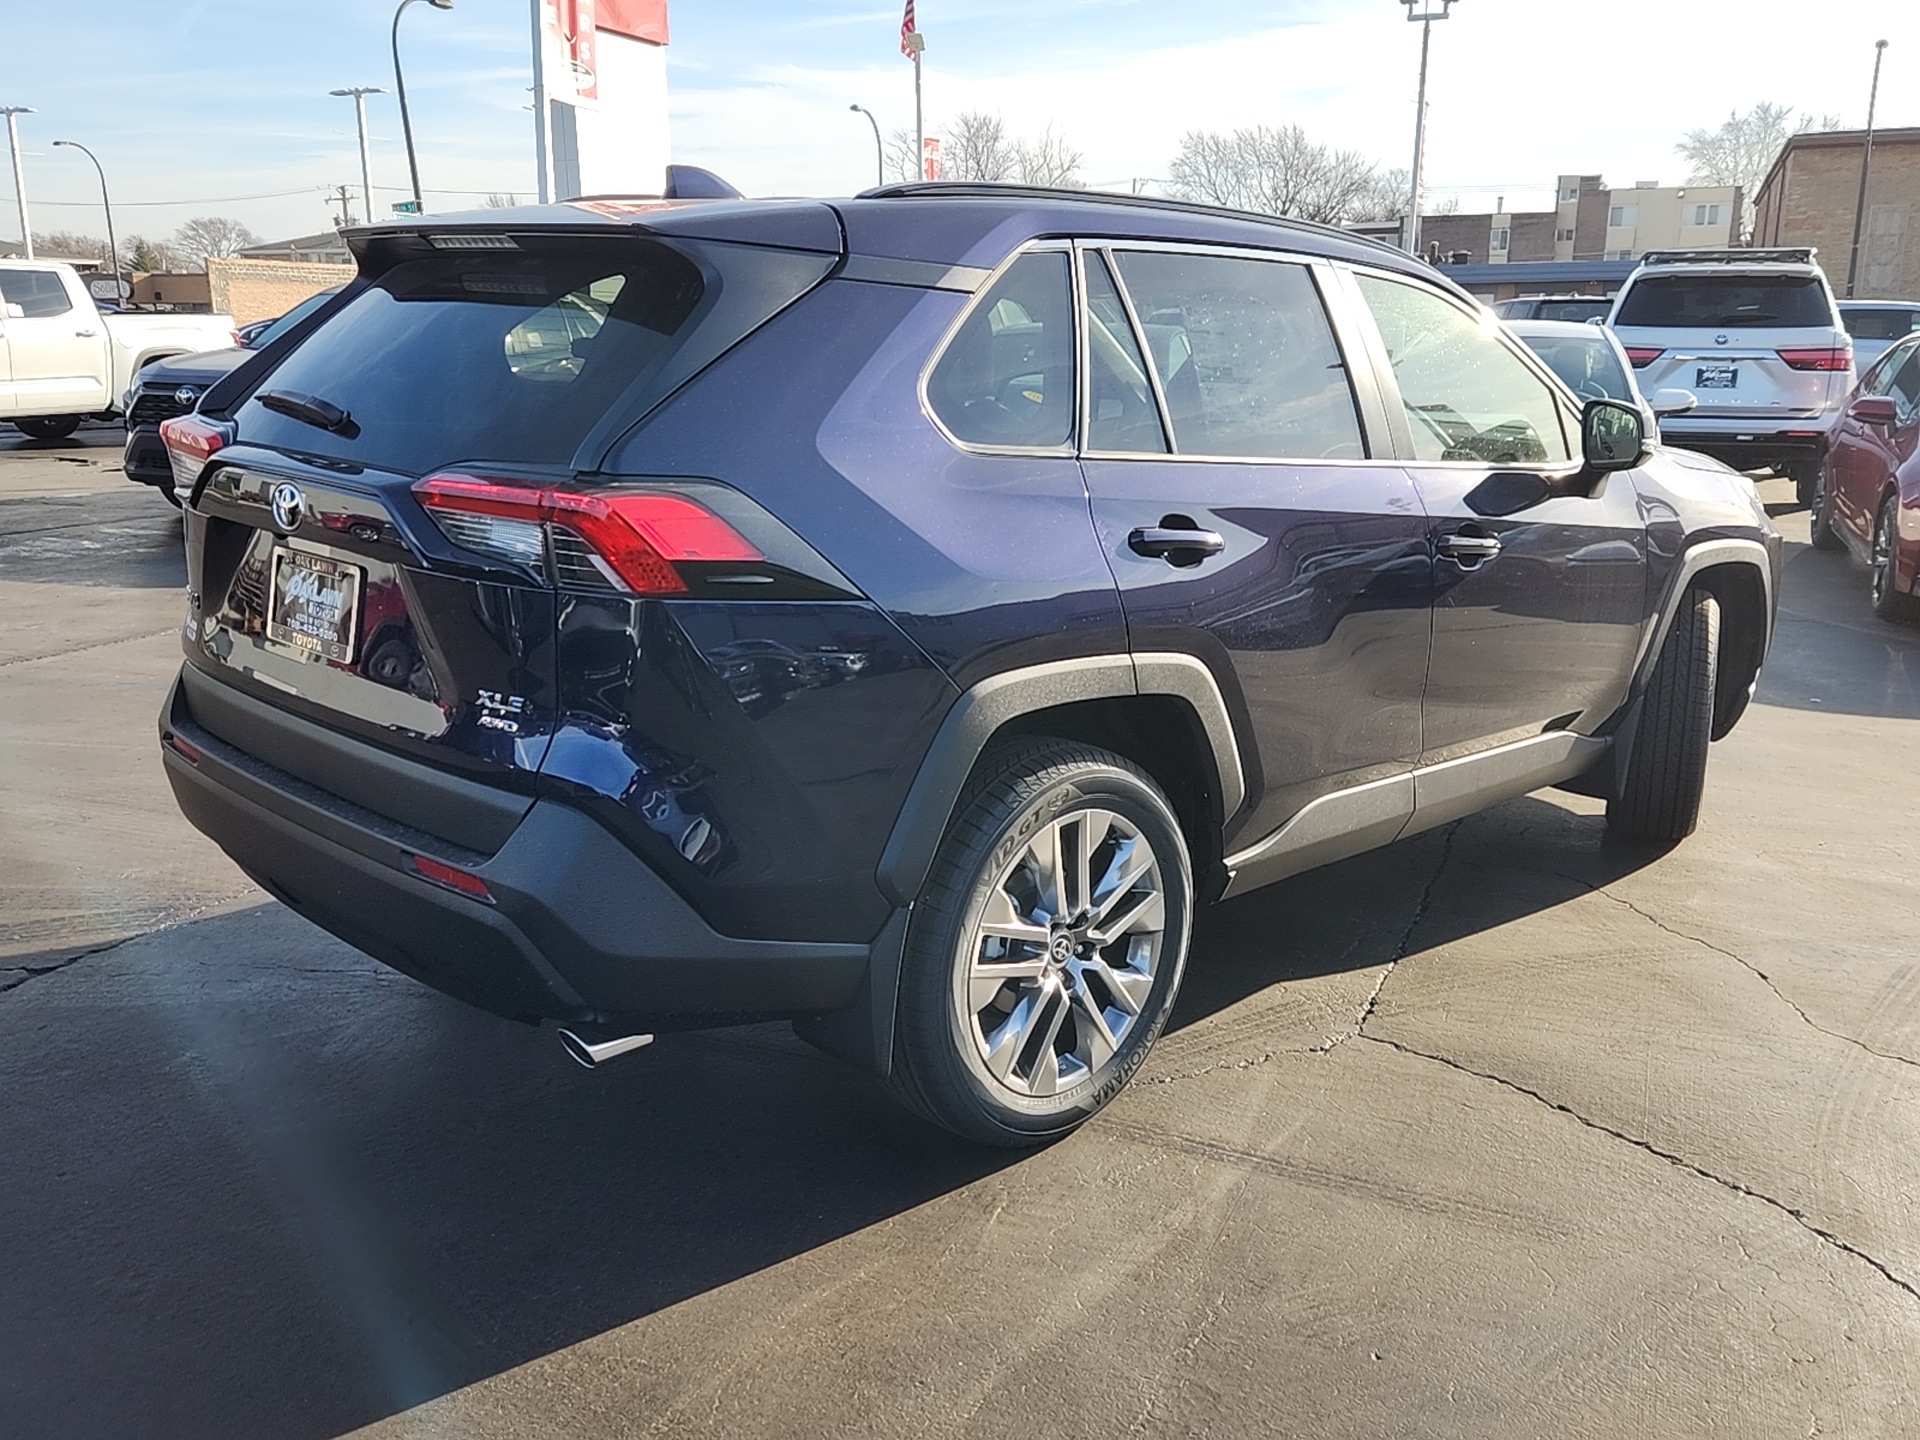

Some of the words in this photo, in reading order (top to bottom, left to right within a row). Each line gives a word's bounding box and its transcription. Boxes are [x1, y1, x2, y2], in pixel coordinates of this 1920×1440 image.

[295, 555, 311, 568] OAK
[312, 559, 334, 574] LAWN
[292, 632, 322, 652] TOYOTA
[475, 690, 524, 713] XLE
[1018, 805, 1043, 836] GT
[1091, 1020, 1161, 1106] YOKOHAMA
